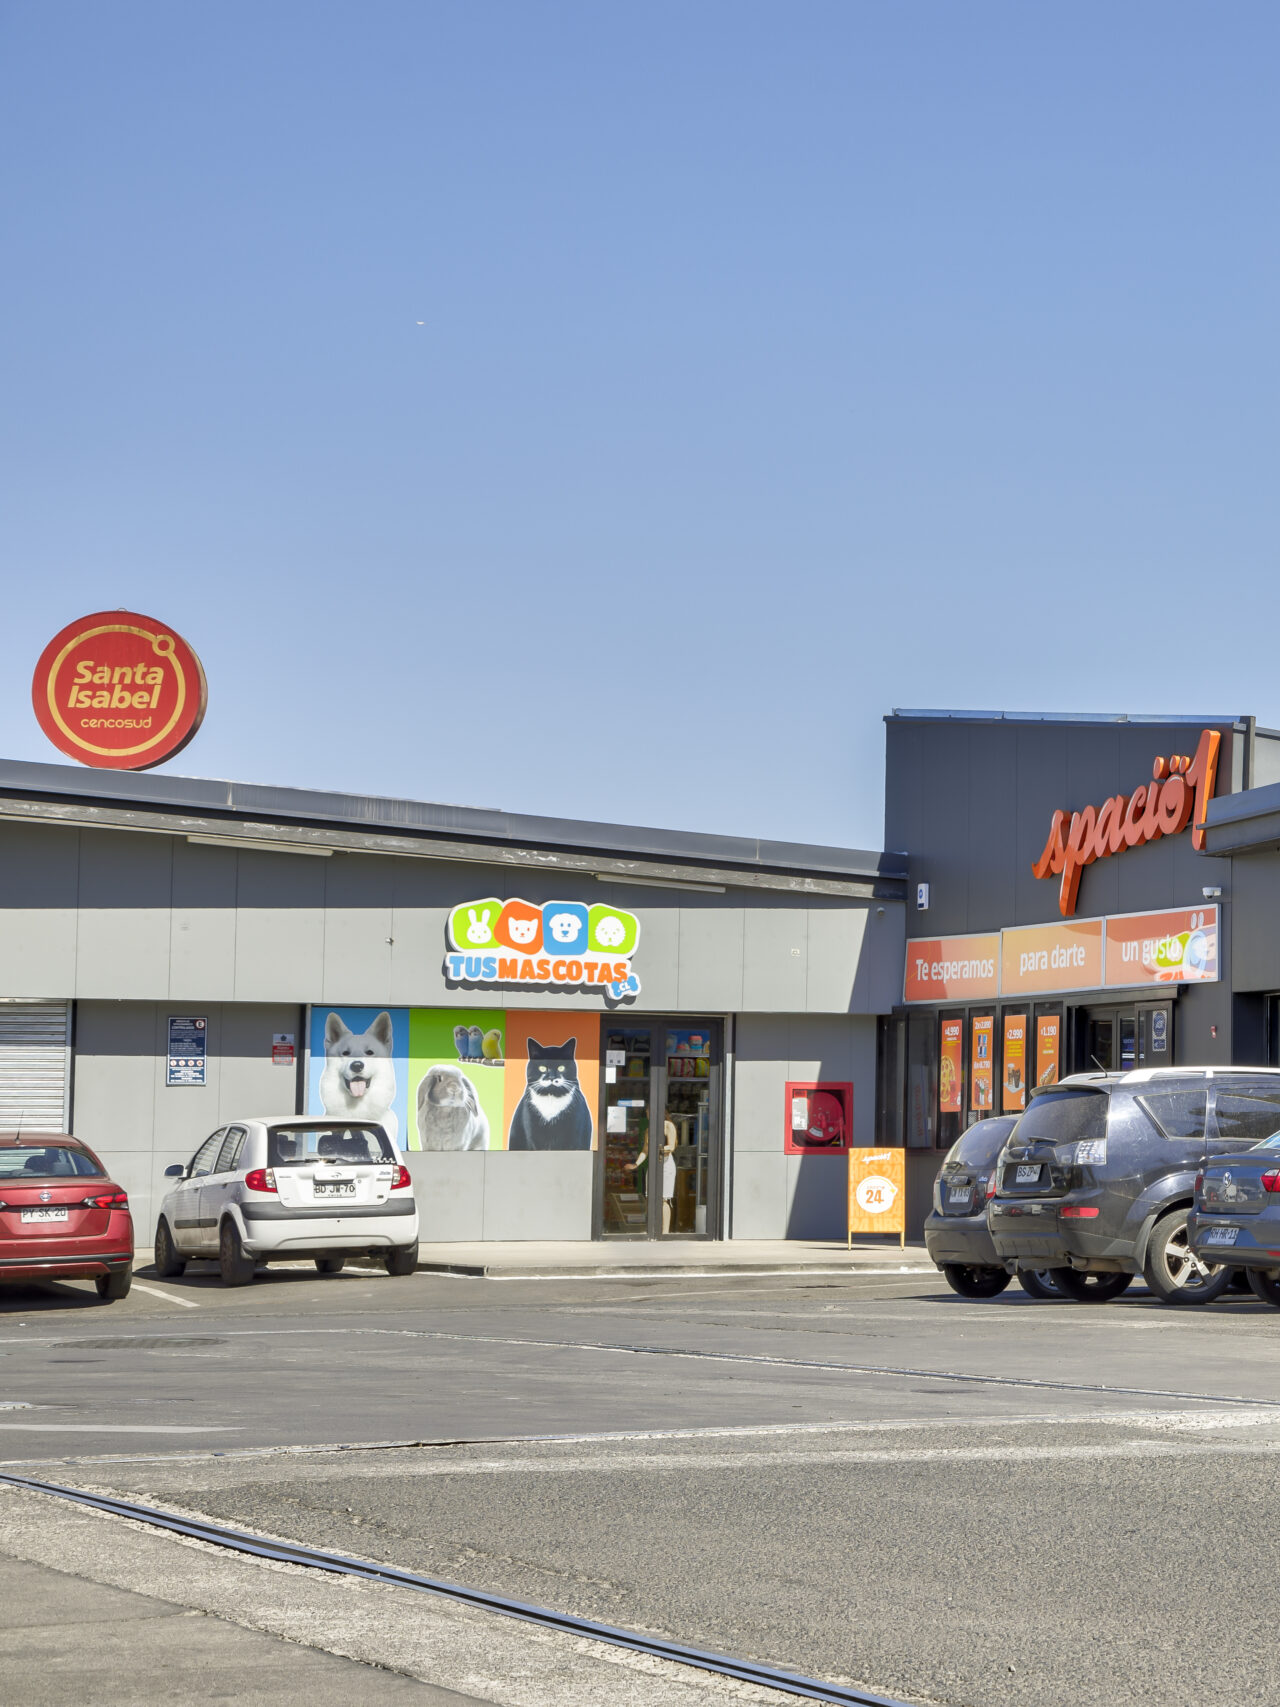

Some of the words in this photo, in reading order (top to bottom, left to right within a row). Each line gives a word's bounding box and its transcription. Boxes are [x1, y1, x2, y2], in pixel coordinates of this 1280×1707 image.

[73, 660, 164, 685] Santa
[67, 684, 162, 709] Isabel
[80, 716, 152, 729] cencosud
[1019, 951, 1048, 977] para
[1051, 944, 1086, 969] darte
[1122, 941, 1139, 962] un
[916, 959, 929, 981] Te
[931, 958, 994, 984] esperamos
[866, 1189, 884, 1204] 24
